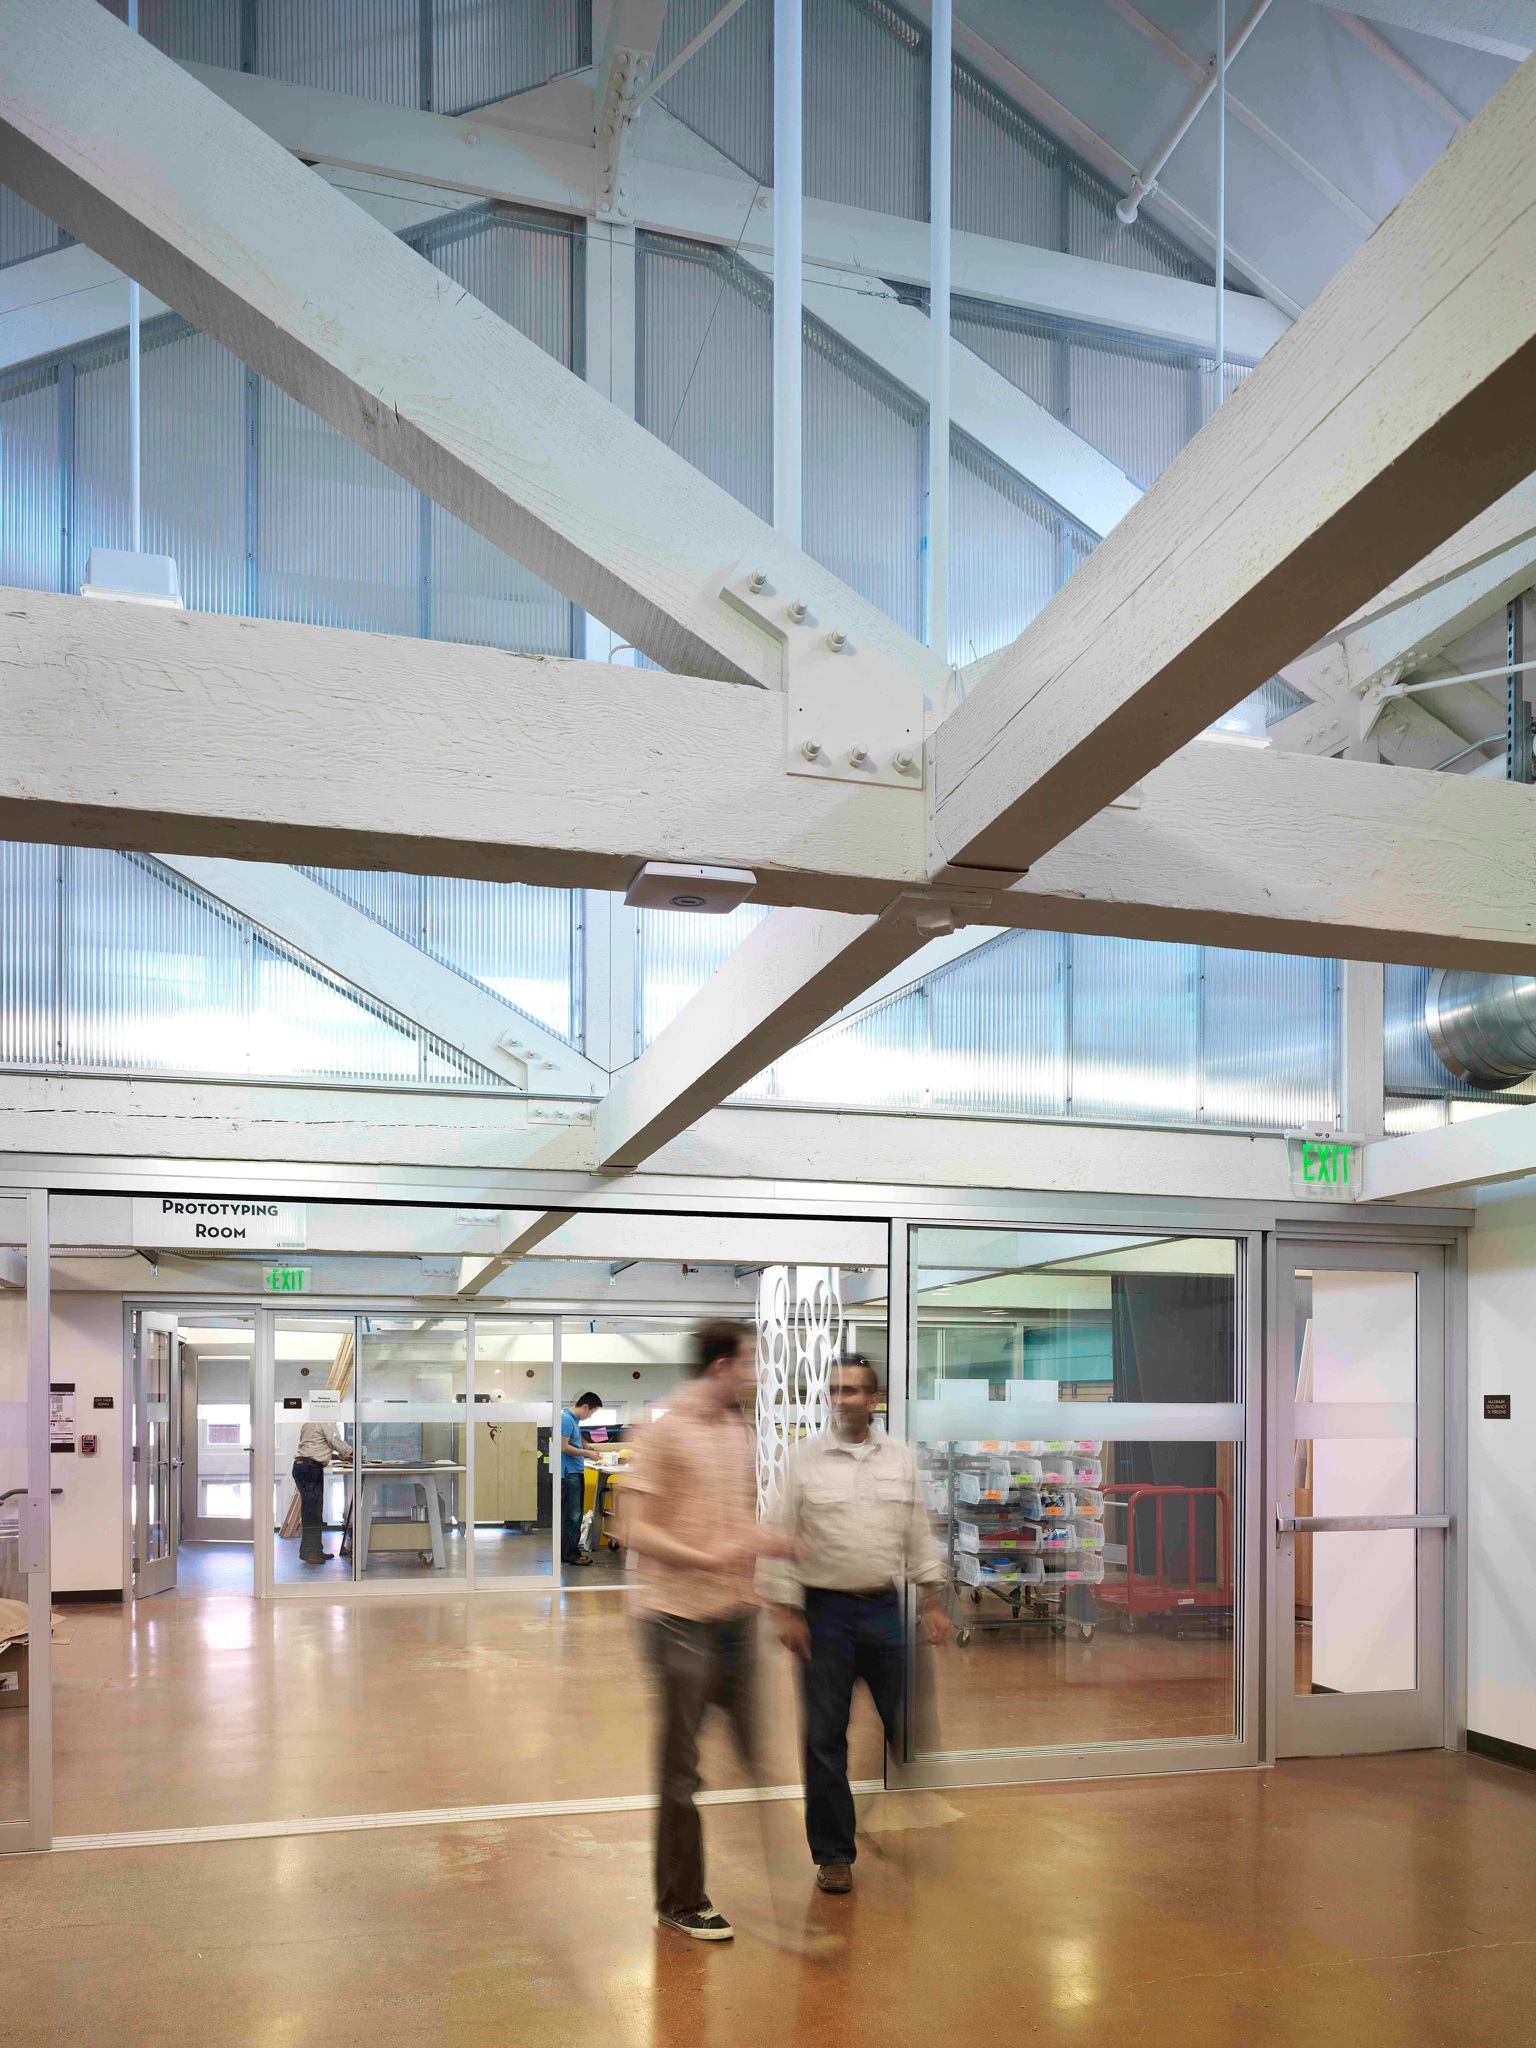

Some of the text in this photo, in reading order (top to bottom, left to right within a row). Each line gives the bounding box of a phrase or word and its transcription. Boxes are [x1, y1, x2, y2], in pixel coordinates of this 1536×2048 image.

[1302, 1143, 1351, 1184] EXIT
[162, 1199, 279, 1216] PROTOTYPING
[195, 1223, 246, 1239] ROOM
[272, 1269, 304, 1291] EXIT
